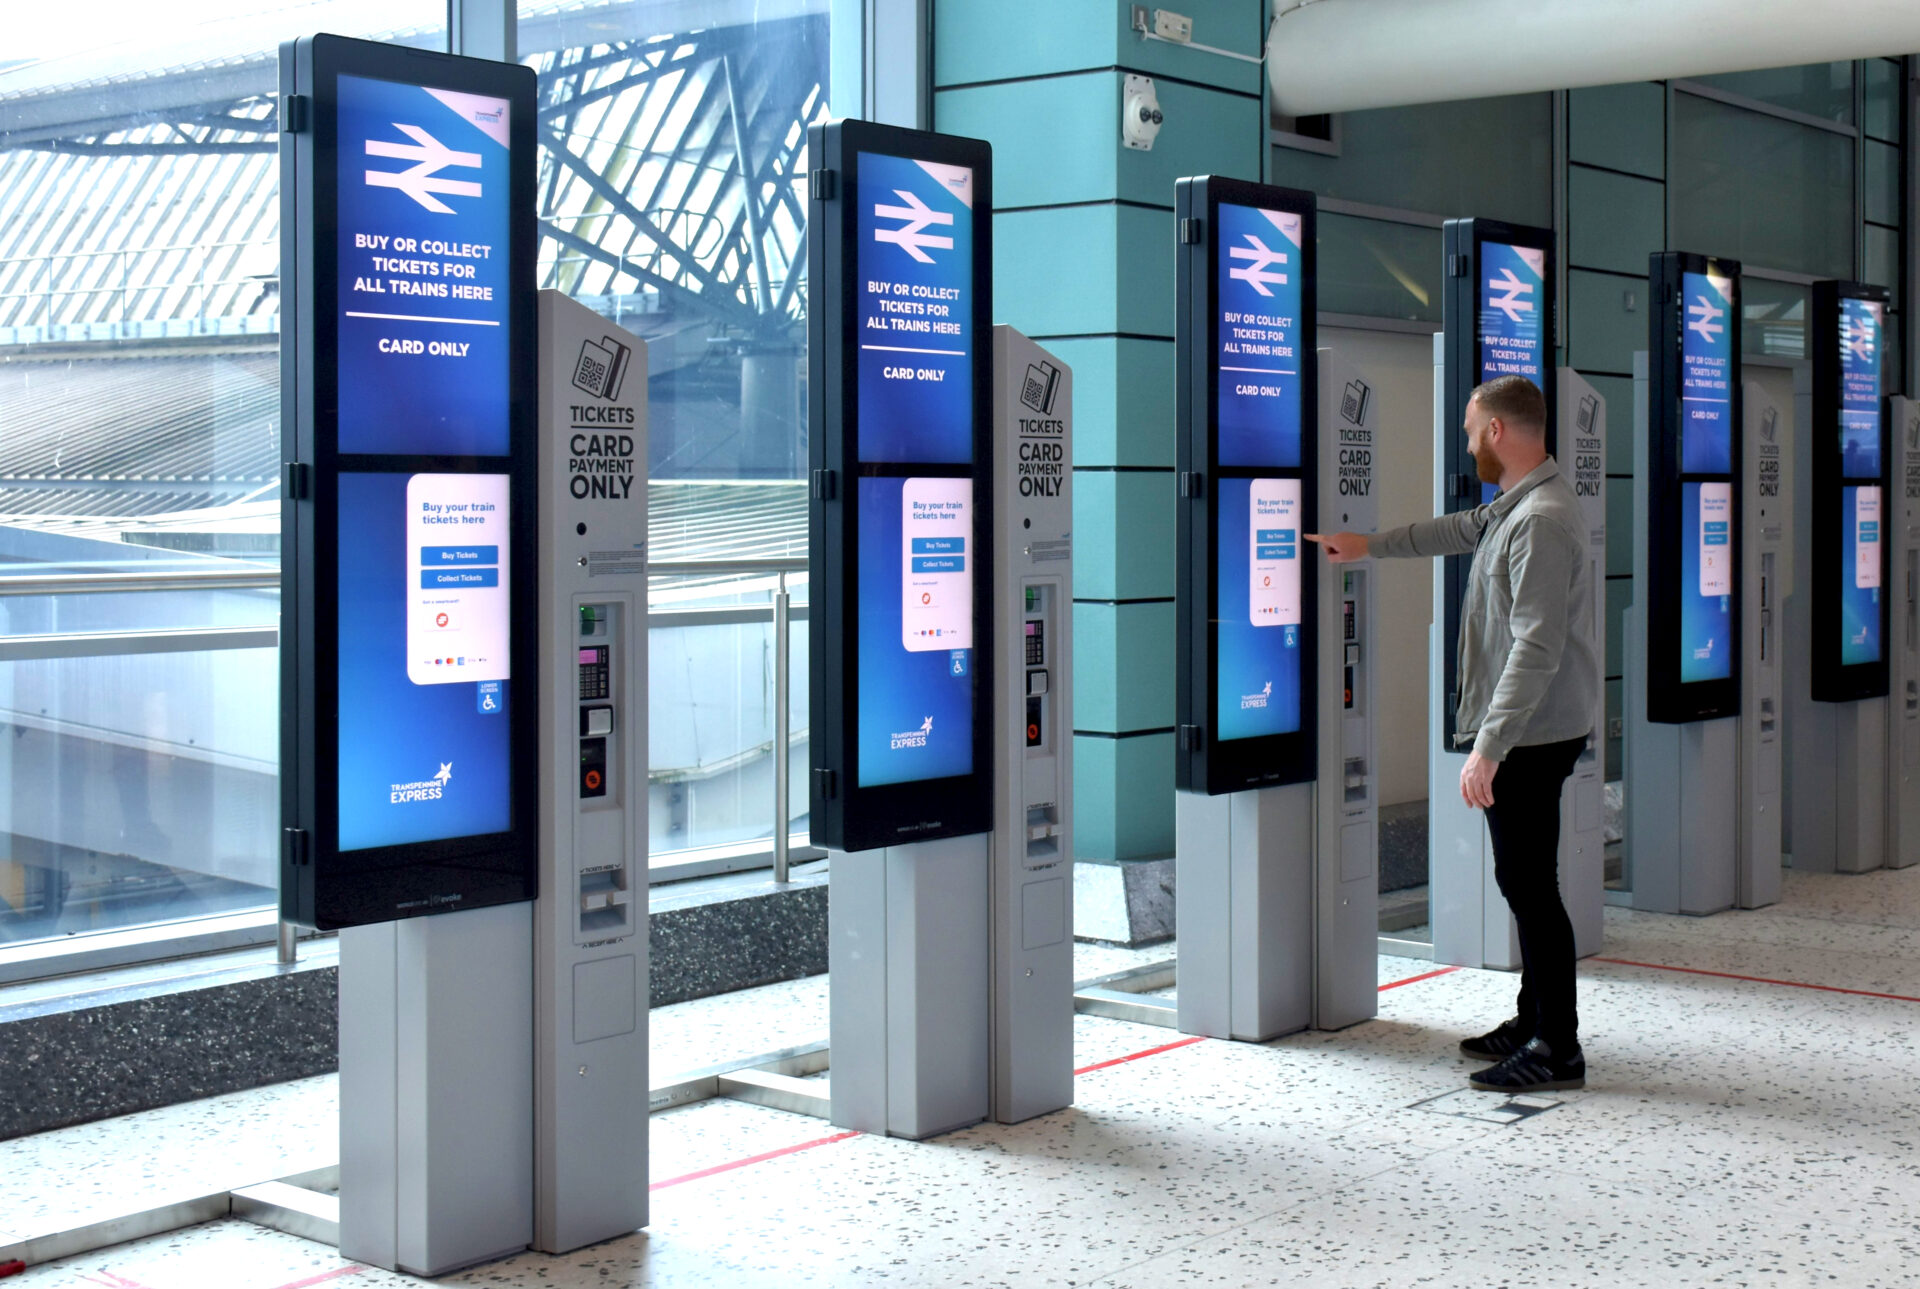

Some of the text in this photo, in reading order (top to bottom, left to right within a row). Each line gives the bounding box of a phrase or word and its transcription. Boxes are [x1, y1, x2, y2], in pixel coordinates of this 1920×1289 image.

[355, 234, 491, 258] BUY OR COLLECT
[373, 257, 475, 278] TICKETS FOR
[354, 277, 493, 300] ALL TRAINS HERE
[868, 281, 959, 300] BUY OR COLLECT
[880, 300, 949, 316] TICKETS FOR
[867, 317, 960, 334] ALL TRAINS HERE
[1225, 312, 1292, 327] BUY OR COLLECT
[1233, 328, 1284, 342] TICKETS FOR
[379, 339, 469, 357] CARD ONLY
[1485, 336, 1536, 349] BUY OR COLLECT
[1224, 343, 1293, 357] ALL TRAINS HERE
[1492, 349, 1530, 361] TICKETS FOR
[884, 367, 945, 381] CARD ONLY
[1485, 362, 1536, 374] ALL TRAINS HERE
[1236, 385, 1281, 396] CARD ONLY
[570, 406, 634, 423] TICKETS
[1019, 419, 1063, 433] TICKETS
[1339, 429, 1371, 442] TICKETS
[570, 434, 633, 457] CARD
[1576, 439, 1600, 448] TICKETS
[1019, 443, 1063, 461] CARD
[1340, 450, 1371, 465] CARD
[570, 459, 634, 473] PAYMENT
[1019, 463, 1063, 475] PAYMENT
[1576, 456, 1600, 469] CARD
[1339, 467, 1371, 477] PAYMENT
[570, 474, 634, 499] ONLY
[1019, 476, 1063, 497] ONLY
[1339, 478, 1371, 496] ONLY
[1576, 482, 1600, 496] ONLY
[1760, 483, 1779, 496] ONLY
[423, 502, 495, 513] Buy your train
[913, 502, 926, 510] Buy
[423, 515, 485, 524] tickets here
[442, 552, 454, 560] Buy
[891, 737, 926, 749] EXPRESS
[391, 780, 441, 791] TRANSPENNINE
[391, 788, 442, 804] EXPRESS
